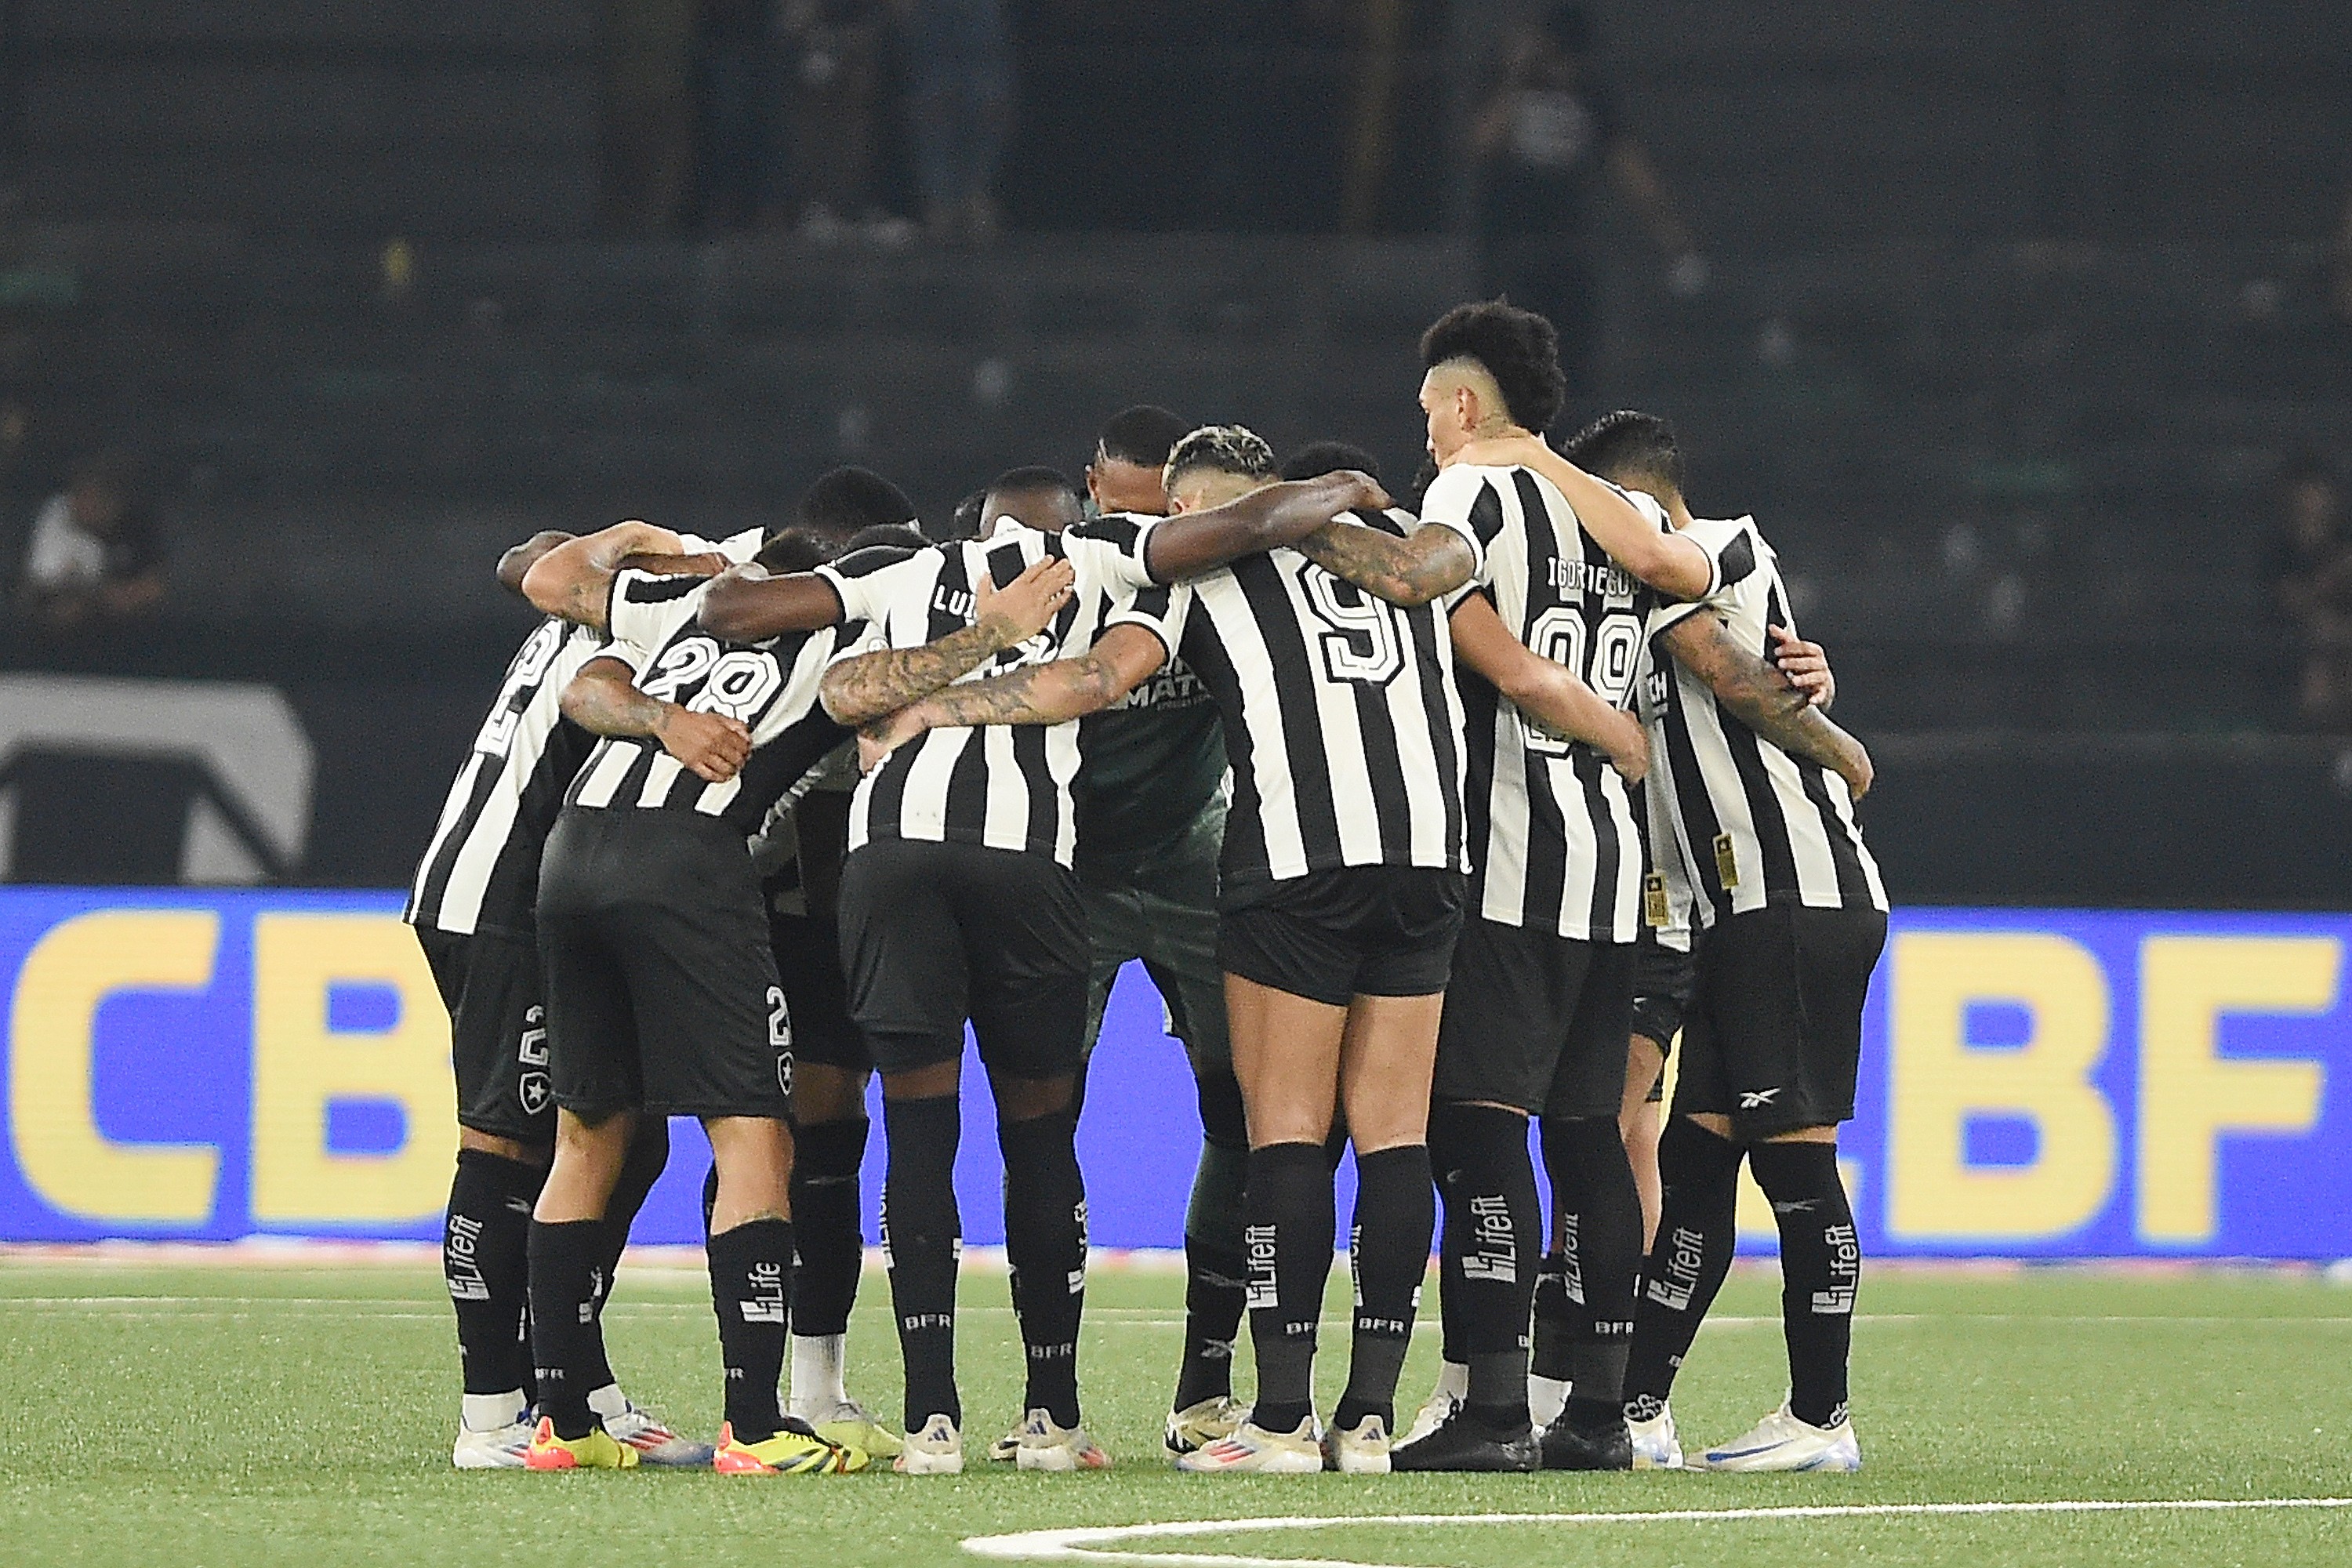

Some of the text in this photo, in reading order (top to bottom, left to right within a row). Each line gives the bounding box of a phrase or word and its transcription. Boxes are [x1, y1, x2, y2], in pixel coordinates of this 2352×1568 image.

[1302, 562, 1401, 683] 9
[904, 1313, 952, 1330] BFR
[1359, 1316, 1405, 1334] BFR
